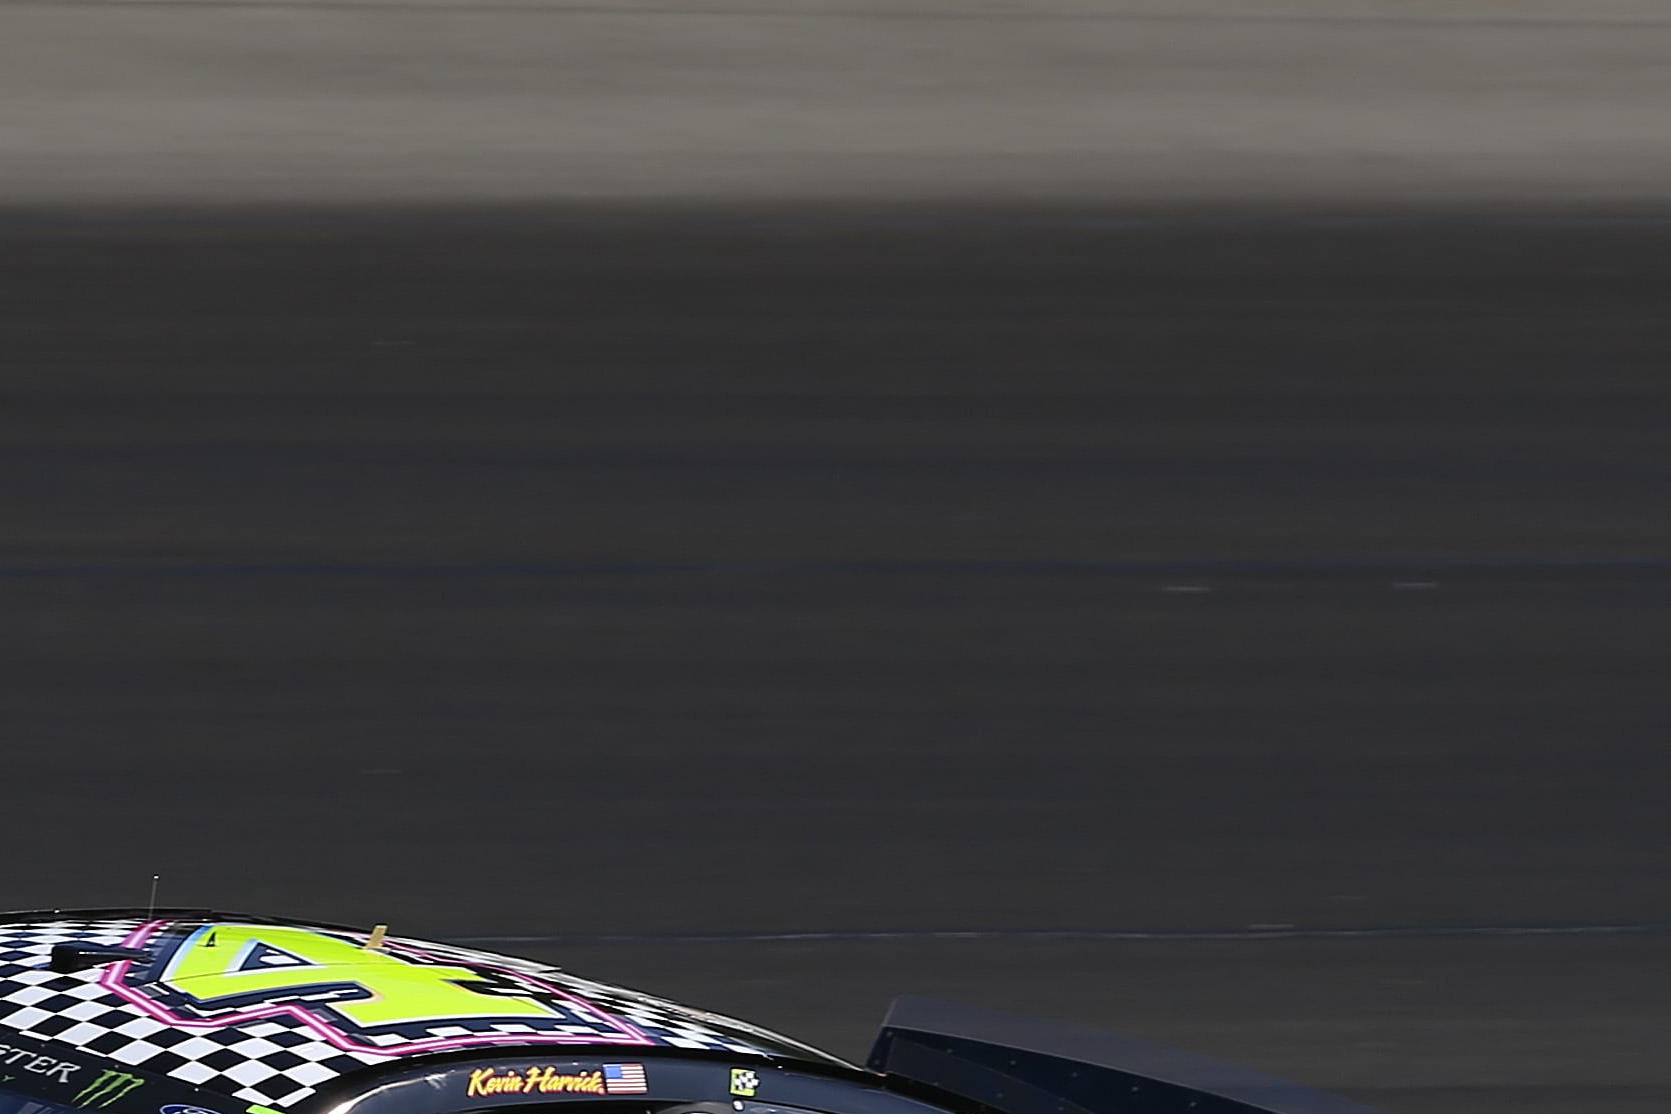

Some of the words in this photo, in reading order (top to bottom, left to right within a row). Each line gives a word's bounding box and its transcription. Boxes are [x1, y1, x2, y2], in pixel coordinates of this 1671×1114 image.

[160, 924, 566, 1028] 4
[468, 1067, 524, 1096] Kevin
[523, 1065, 604, 1095] Harvick
